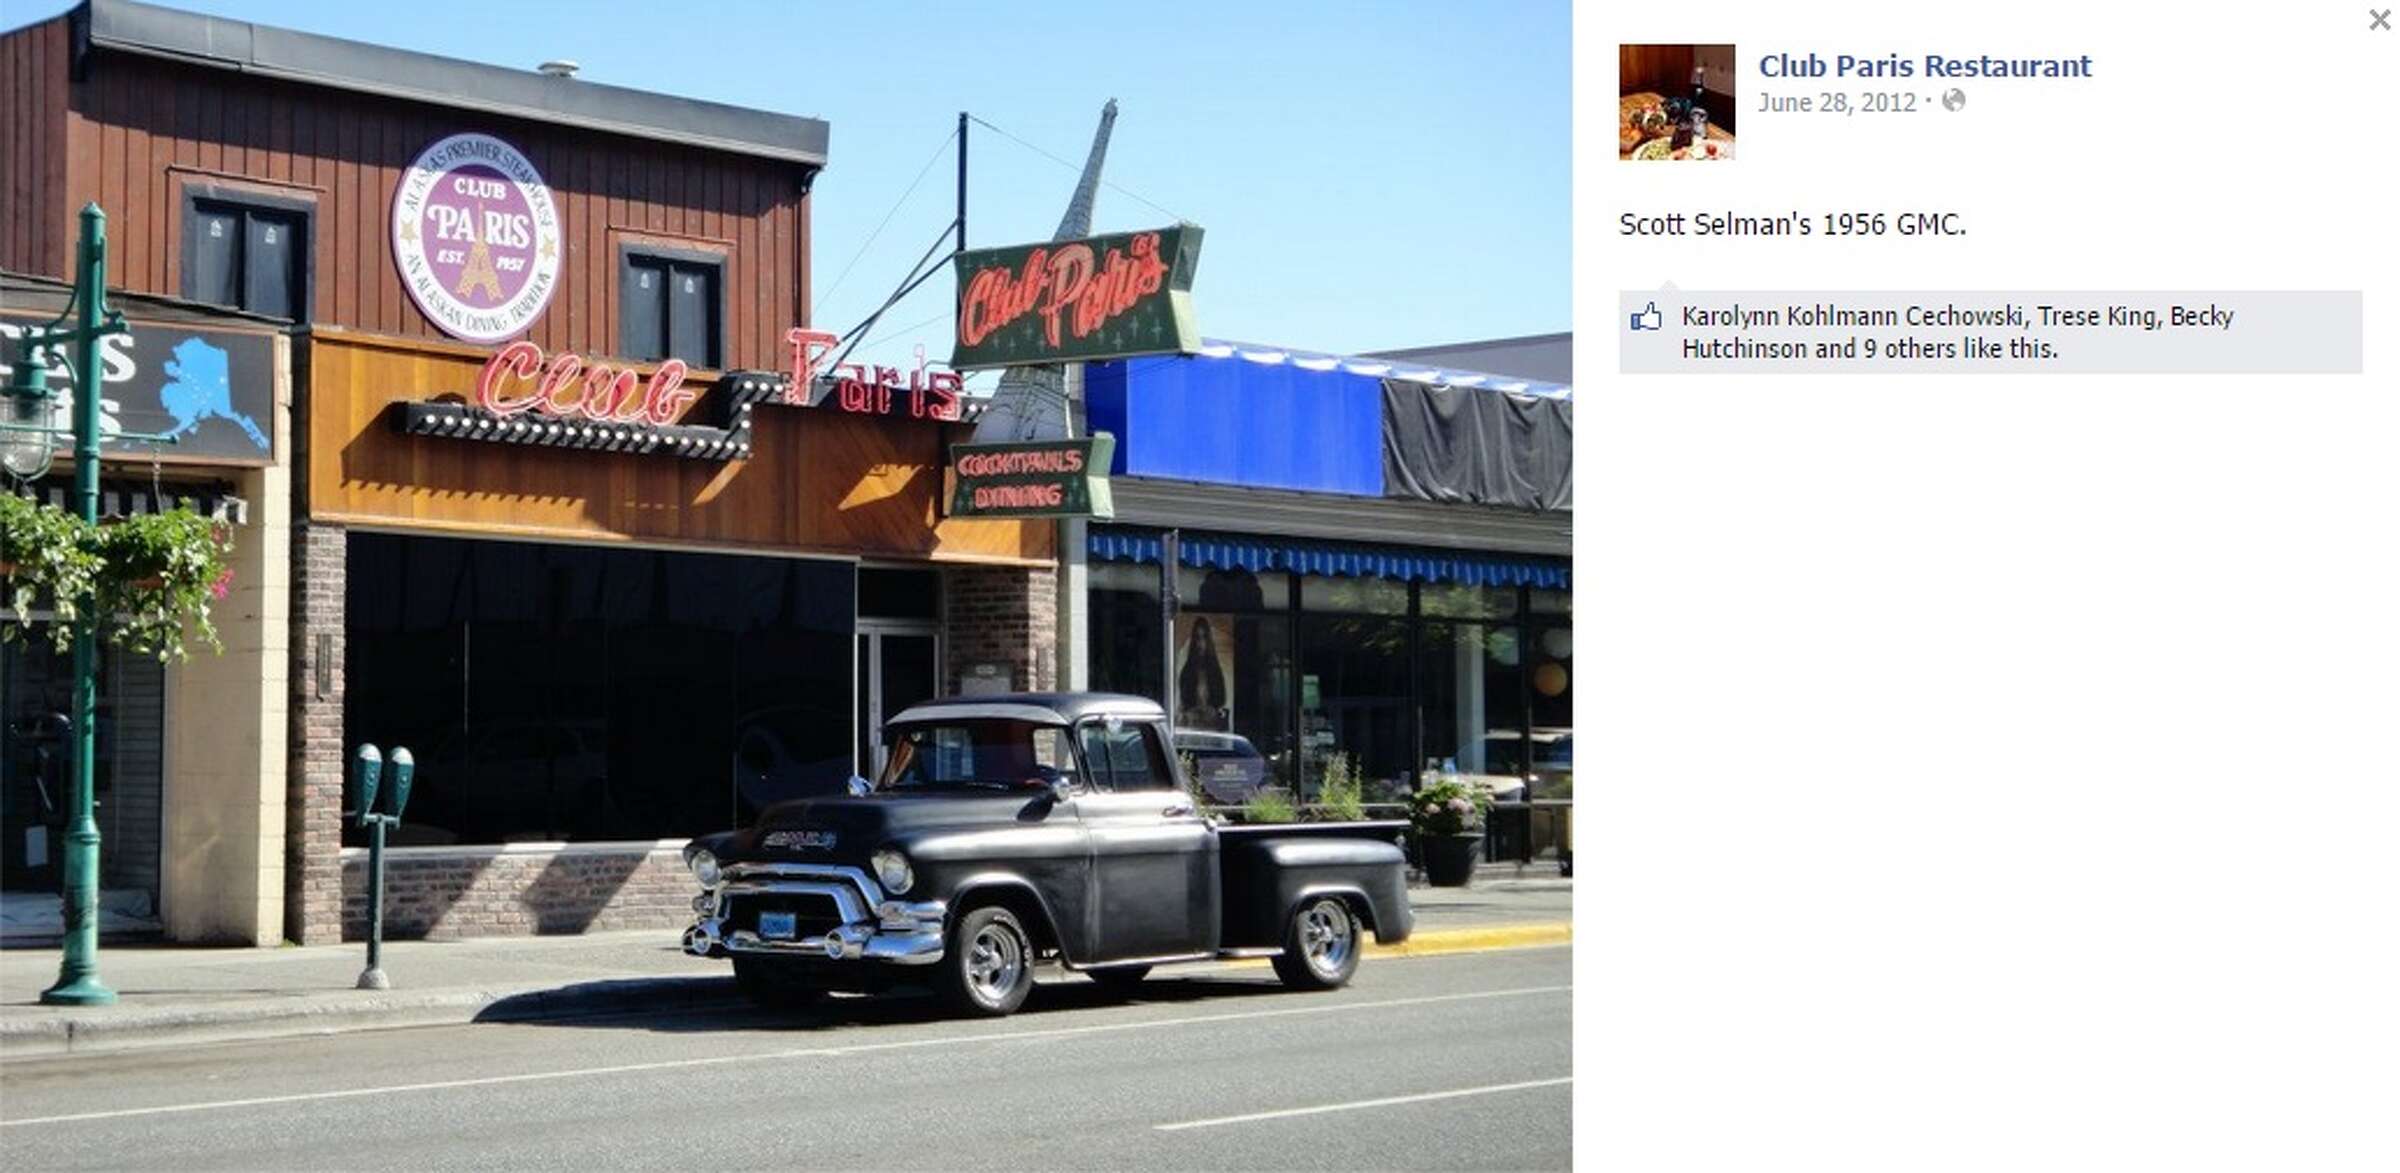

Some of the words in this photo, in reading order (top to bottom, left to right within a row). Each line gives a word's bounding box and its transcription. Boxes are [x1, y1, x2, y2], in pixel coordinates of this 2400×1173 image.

[454, 177, 507, 200] CLUB
[960, 247, 1050, 347] Club
[1040, 232, 1168, 349] Paris
[477, 341, 696, 426] Club
[784, 327, 964, 421] Paris
[957, 450, 1083, 476] COCKTAILS
[974, 482, 1063, 508] DINING
